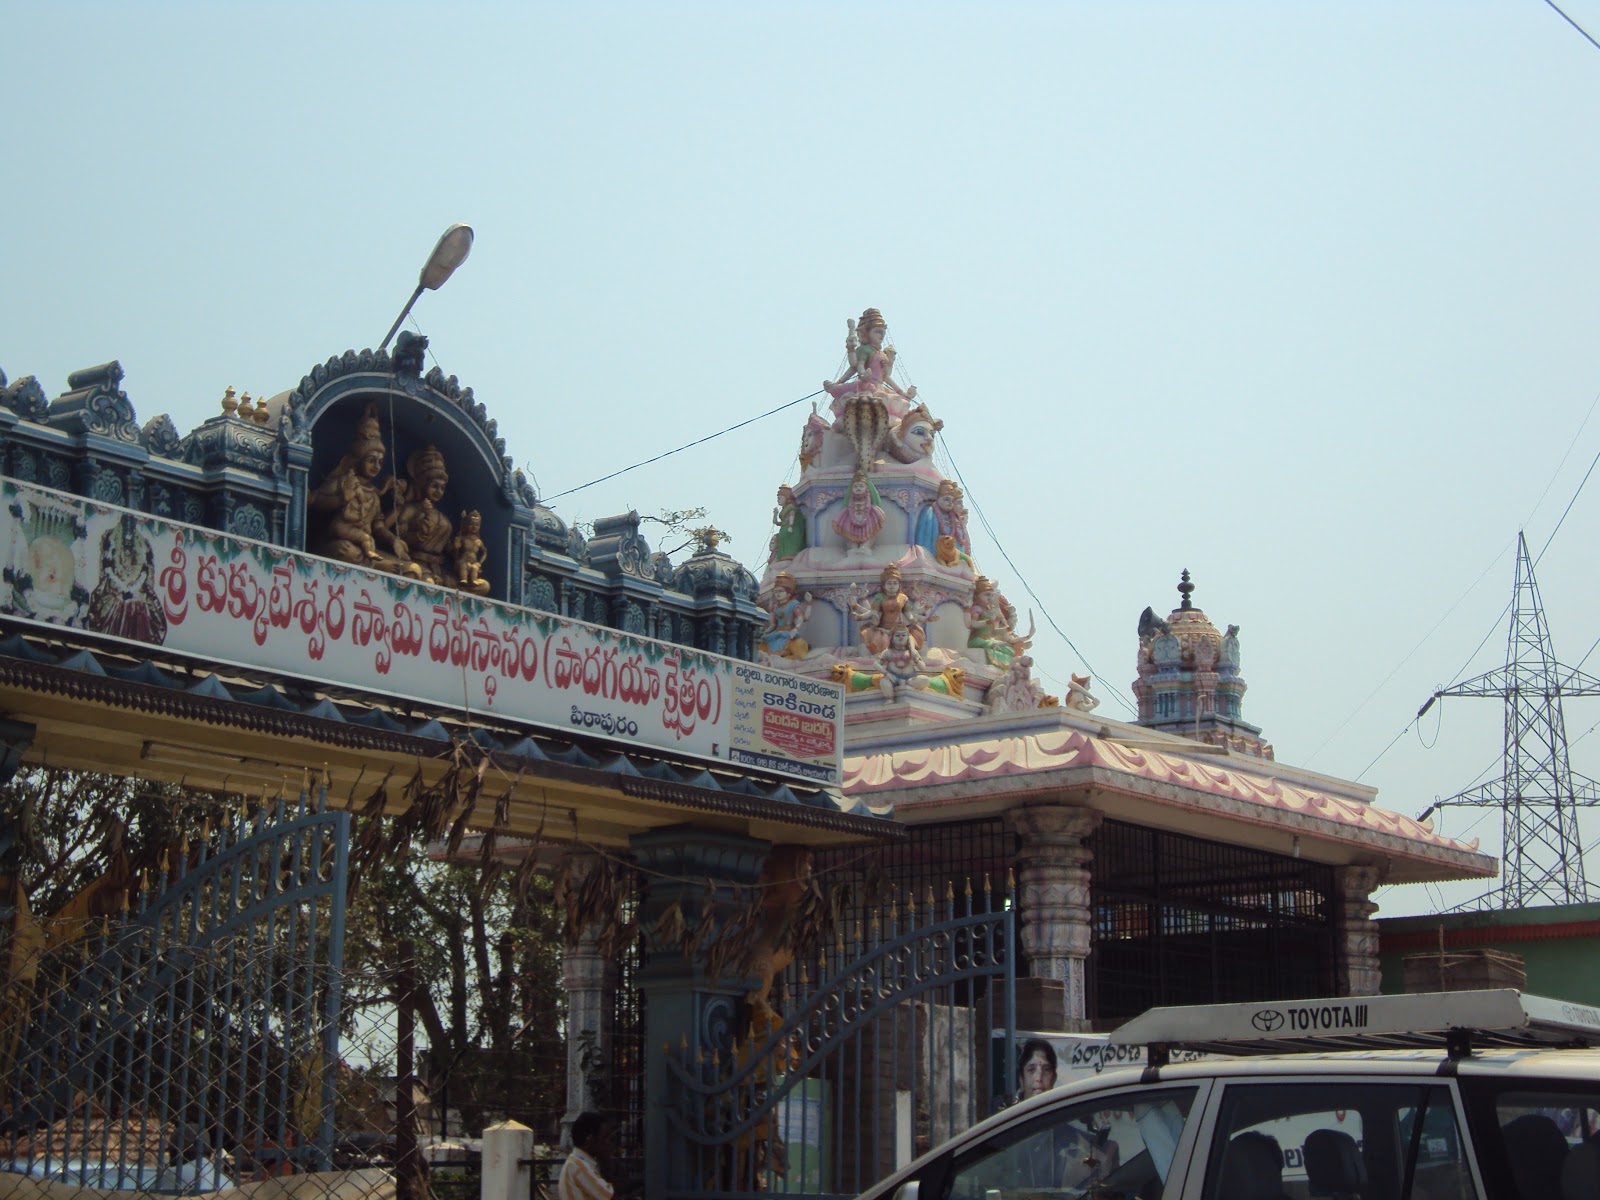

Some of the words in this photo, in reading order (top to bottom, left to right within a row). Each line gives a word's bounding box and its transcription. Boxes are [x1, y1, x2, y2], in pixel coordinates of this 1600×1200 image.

[159, 531, 189, 626] శ్రీ
[196, 555, 346, 661] కుక్కుటేశ్వర
[352, 589, 423, 675] స్వామి
[429, 596, 538, 706] దేవస్థానం
[765, 673, 798, 690] బంగారు
[763, 692, 836, 720] కాకినాడ
[570, 705, 638, 736] పిఠాపురం
[765, 712, 800, 729] చందన
[801, 719, 833, 740] బ్రదర్స్
[740, 754, 755, 765] 100%
